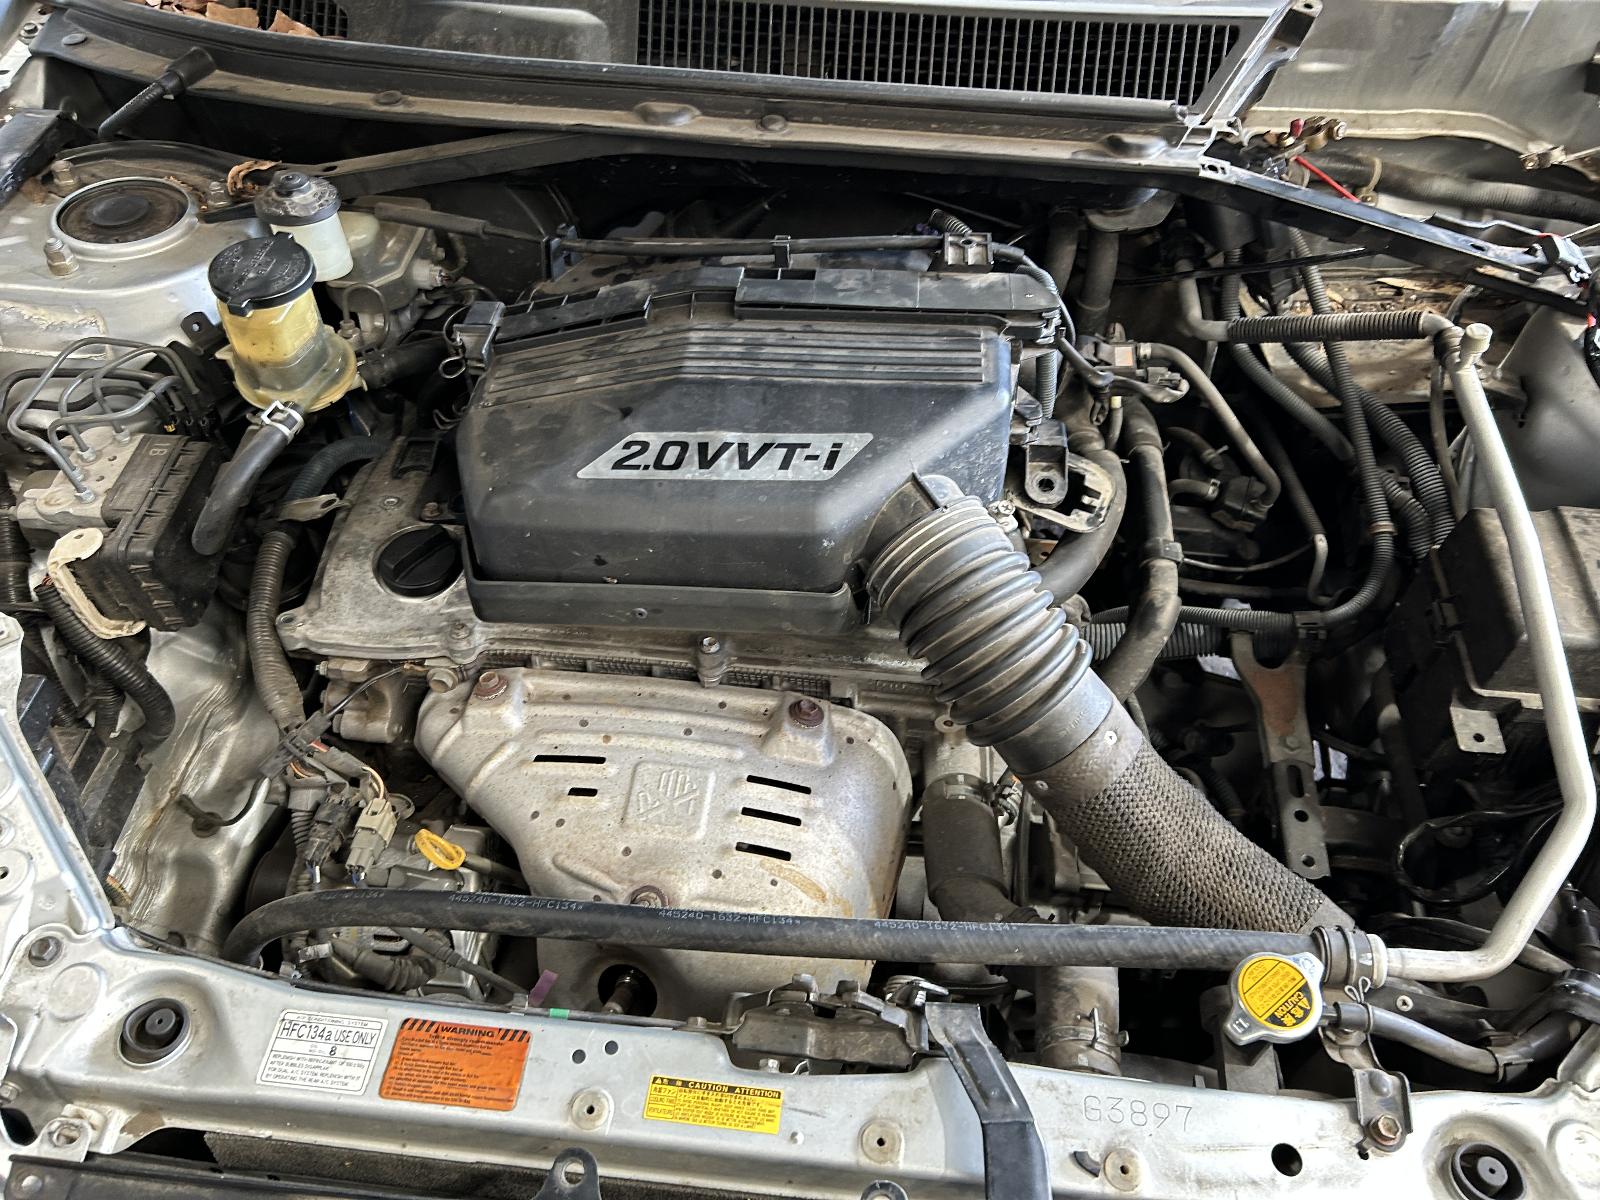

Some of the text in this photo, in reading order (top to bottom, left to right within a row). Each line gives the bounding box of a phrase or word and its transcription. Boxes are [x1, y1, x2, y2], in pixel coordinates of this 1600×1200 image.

[1274, 991, 1304, 1019] CAUTION
[280, 1021, 377, 1045] HFC134a USE ONLY
[441, 1026, 495, 1037] WARNING
[329, 1045, 337, 1056] 8
[688, 1081, 729, 1093] CAUTION
[735, 1087, 779, 1098] ATTENTION
[1084, 1095, 1193, 1132] G3897
